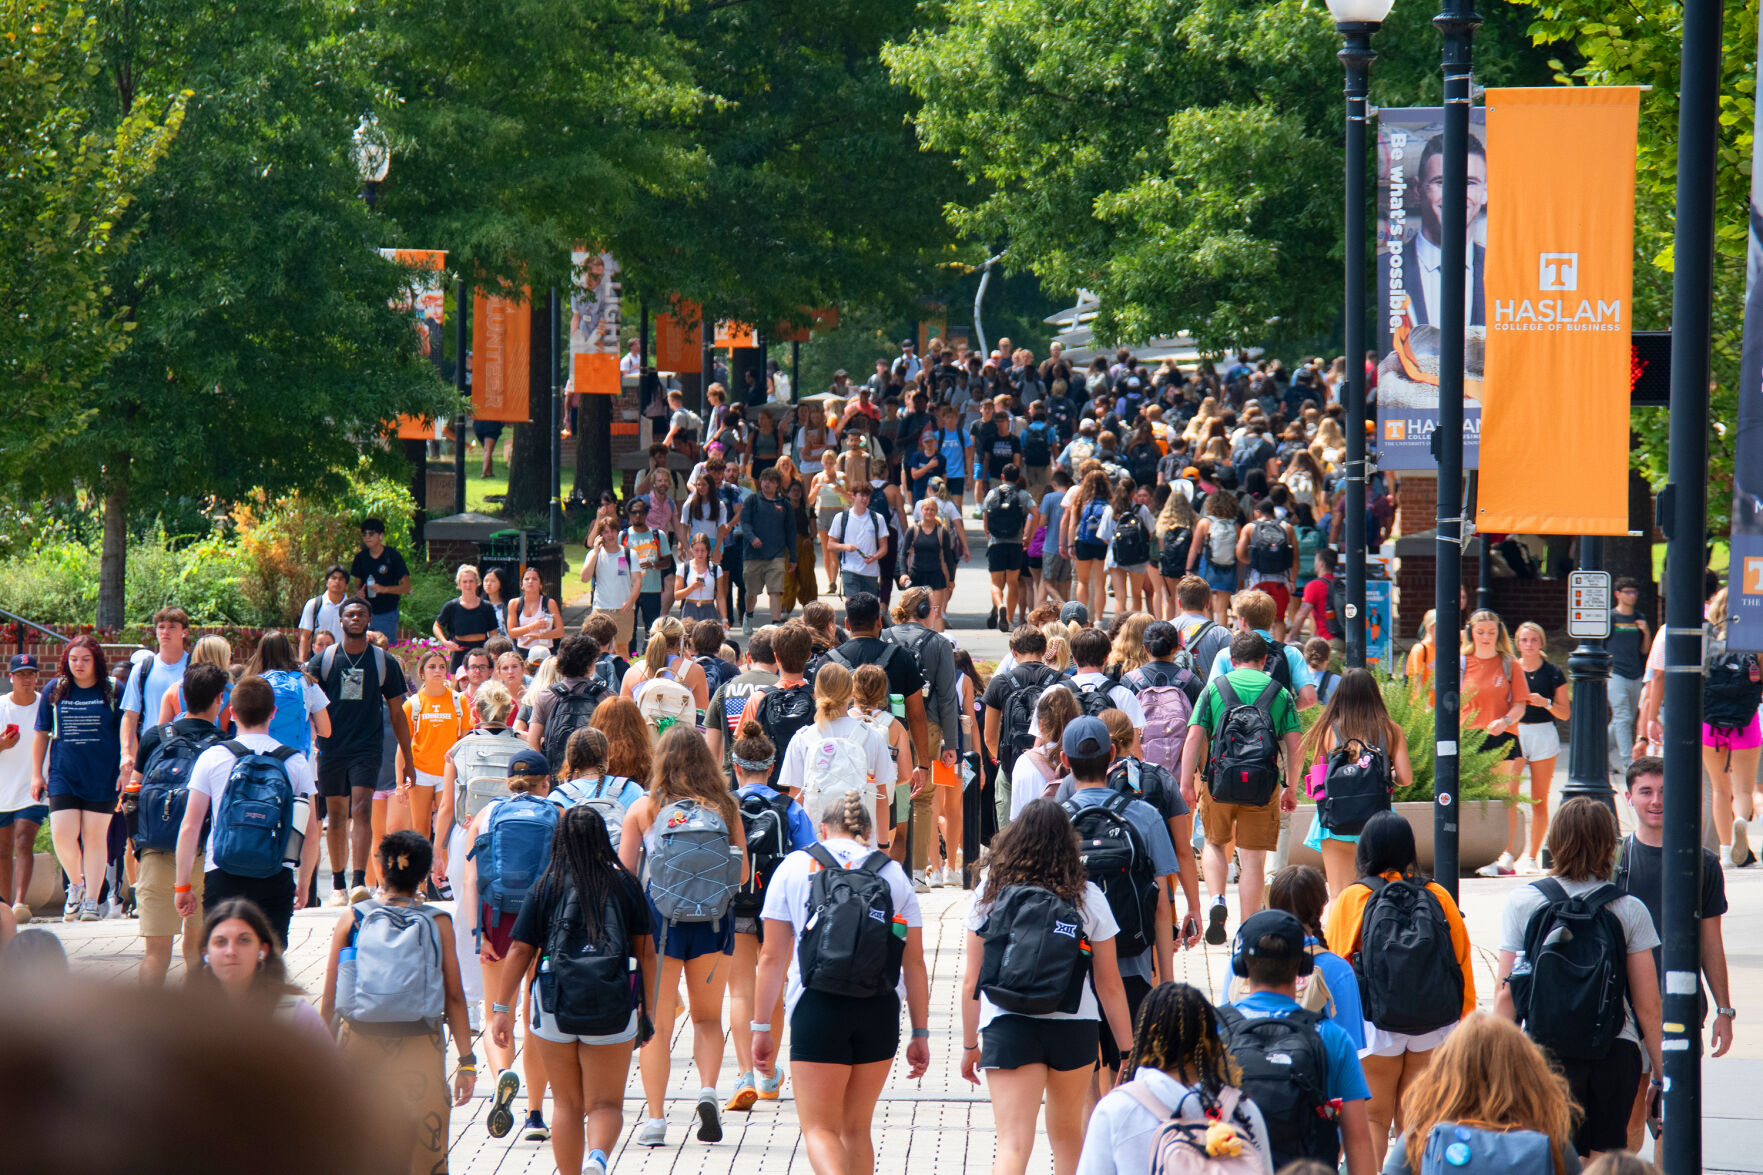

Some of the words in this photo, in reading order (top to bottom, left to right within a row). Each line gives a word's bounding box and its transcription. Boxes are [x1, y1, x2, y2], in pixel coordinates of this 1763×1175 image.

[1390, 134, 1407, 160] Be
[1389, 165, 1407, 236] what's
[1545, 258, 1573, 286] T
[1387, 240, 1407, 334] possible.
[1495, 299, 1620, 322] HASLAM
[1494, 323, 1543, 331] COLLEGE
[1548, 323, 1563, 331] OF
[1567, 323, 1621, 331] BUSINESS
[1386, 421, 1403, 438] T
[1743, 598, 1760, 607] THE
[431, 704, 440, 712] T
